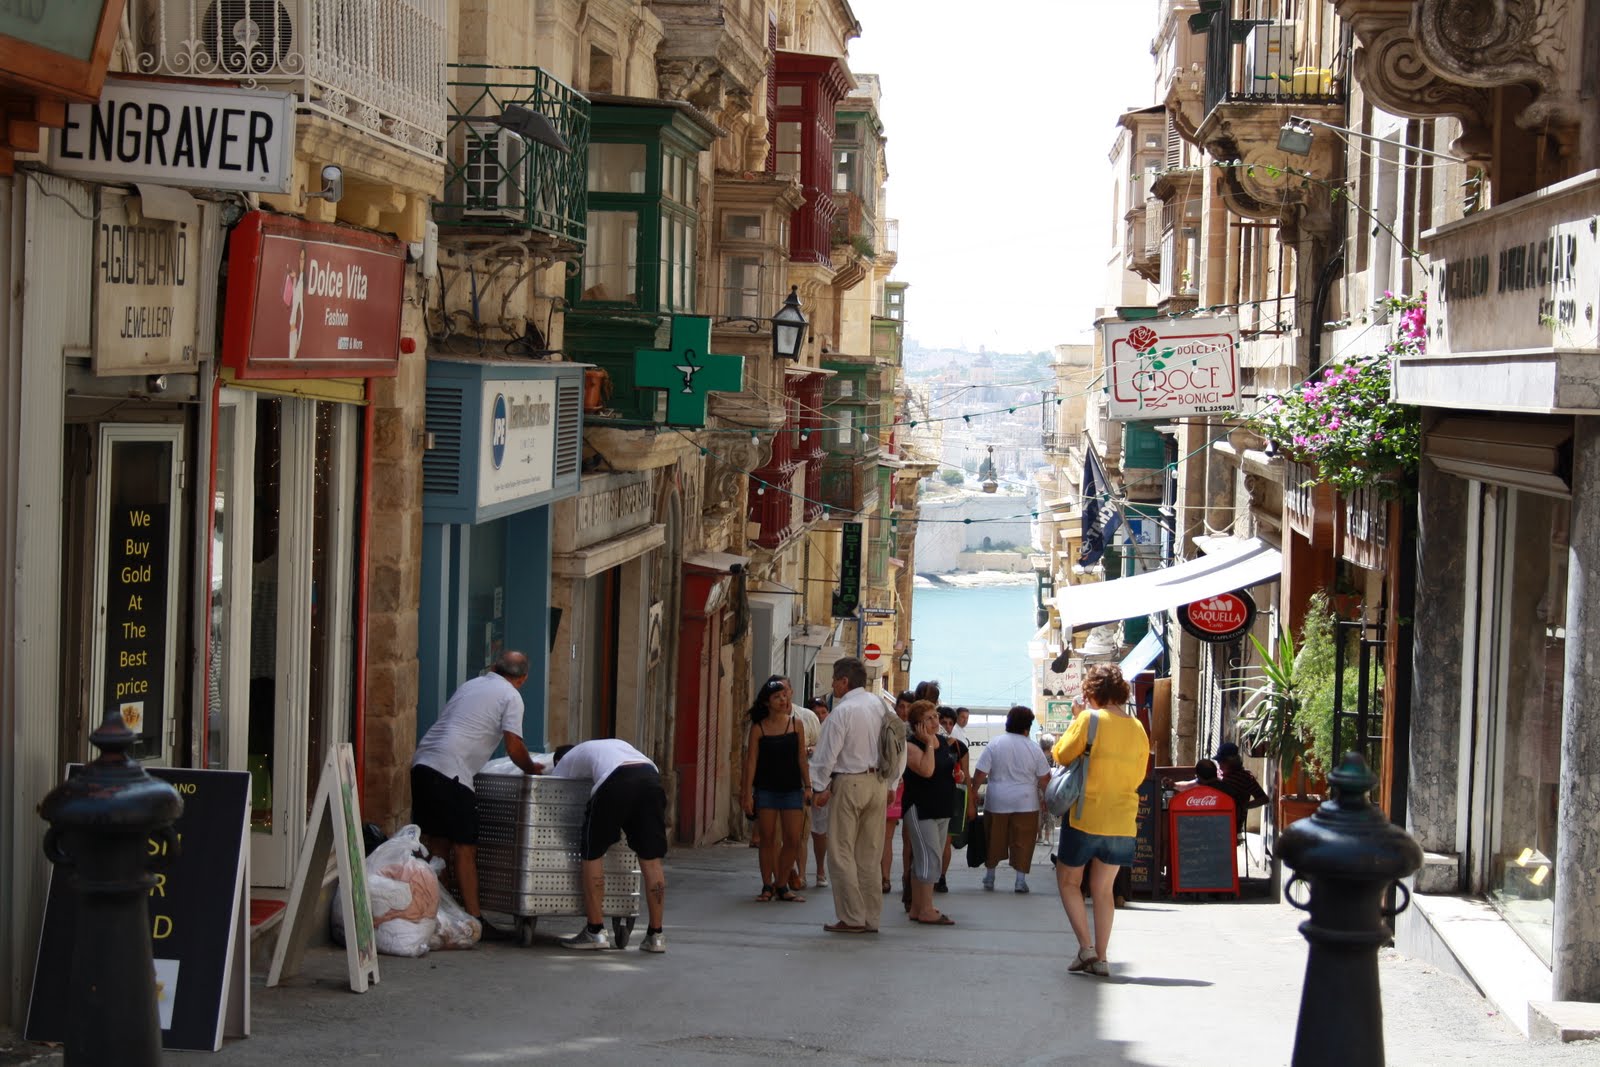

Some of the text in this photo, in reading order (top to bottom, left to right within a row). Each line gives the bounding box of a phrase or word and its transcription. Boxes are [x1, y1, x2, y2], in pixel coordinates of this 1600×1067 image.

[60, 100, 274, 174] ENGRAVER
[308, 259, 368, 301] Dolce Vita
[120, 305, 175, 339] JEWELLERY
[324, 307, 349, 326] Fashion
[1131, 366, 1220, 393] CROCE
[1178, 392, 1219, 405] BONACI
[129, 510, 151, 528] We
[125, 538, 150, 558] Buy
[121, 565, 151, 584] Gold
[127, 595, 143, 611] At
[1191, 610, 1242, 624] SAQUELLA
[122, 622, 146, 640] The
[1212, 628, 1246, 641] CAPPUCCINO
[119, 650, 147, 668] Best
[116, 677, 149, 699] price
